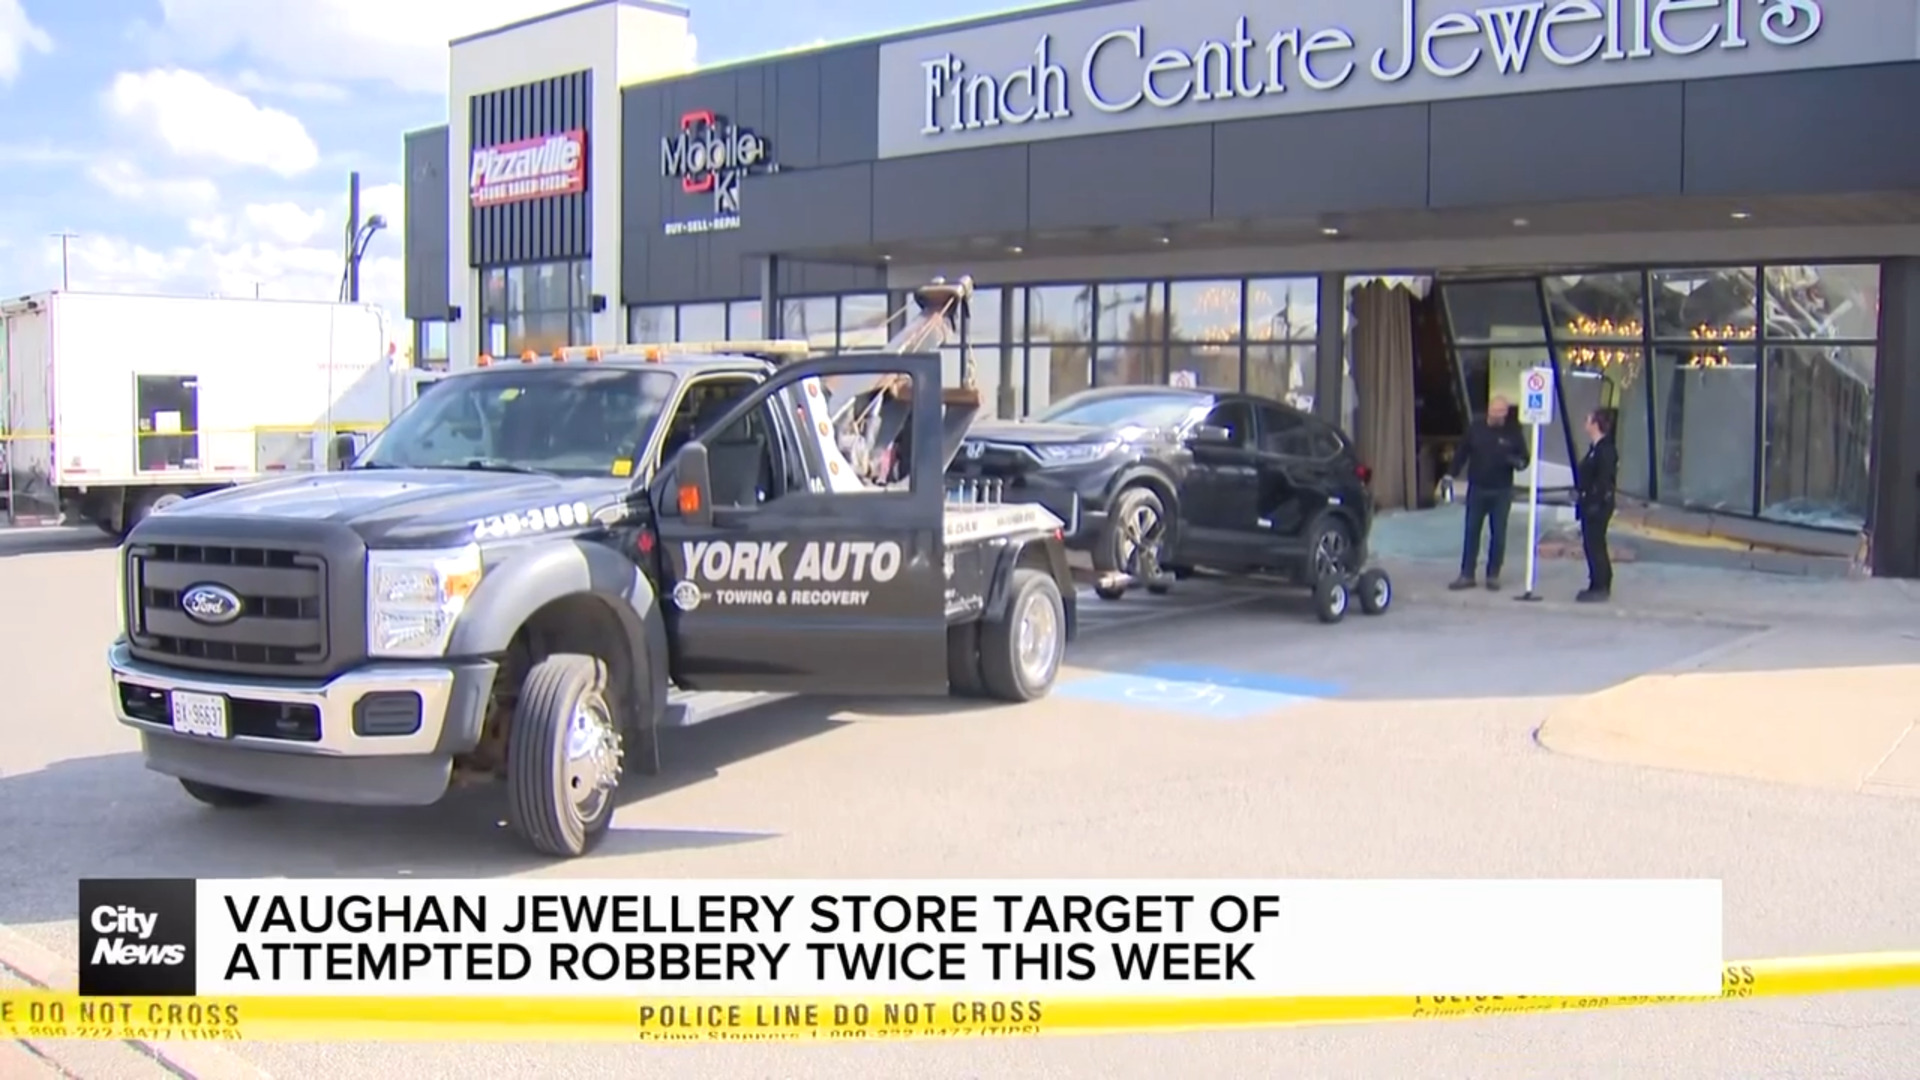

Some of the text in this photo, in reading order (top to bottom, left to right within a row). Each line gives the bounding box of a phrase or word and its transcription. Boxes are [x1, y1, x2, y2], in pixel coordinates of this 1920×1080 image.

[920, 0, 1822, 134] Finch Centre Jewellers
[470, 136, 580, 187] Pizzaville
[661, 124, 757, 176] Mobile
[713, 216, 740, 230] REPAI
[682, 541, 901, 582] YORK AUTO
[192, 592, 223, 613] Ford
[716, 590, 773, 604] TOWING
[777, 590, 787, 604] &
[792, 590, 869, 604] RECOVERY
[30, 1002, 64, 1023] DO
[80, 1002, 132, 1024] NOT
[149, 1003, 239, 1026] CROSS
[640, 1001, 1041, 1027] POLICE LINE DO NOT CROSS
